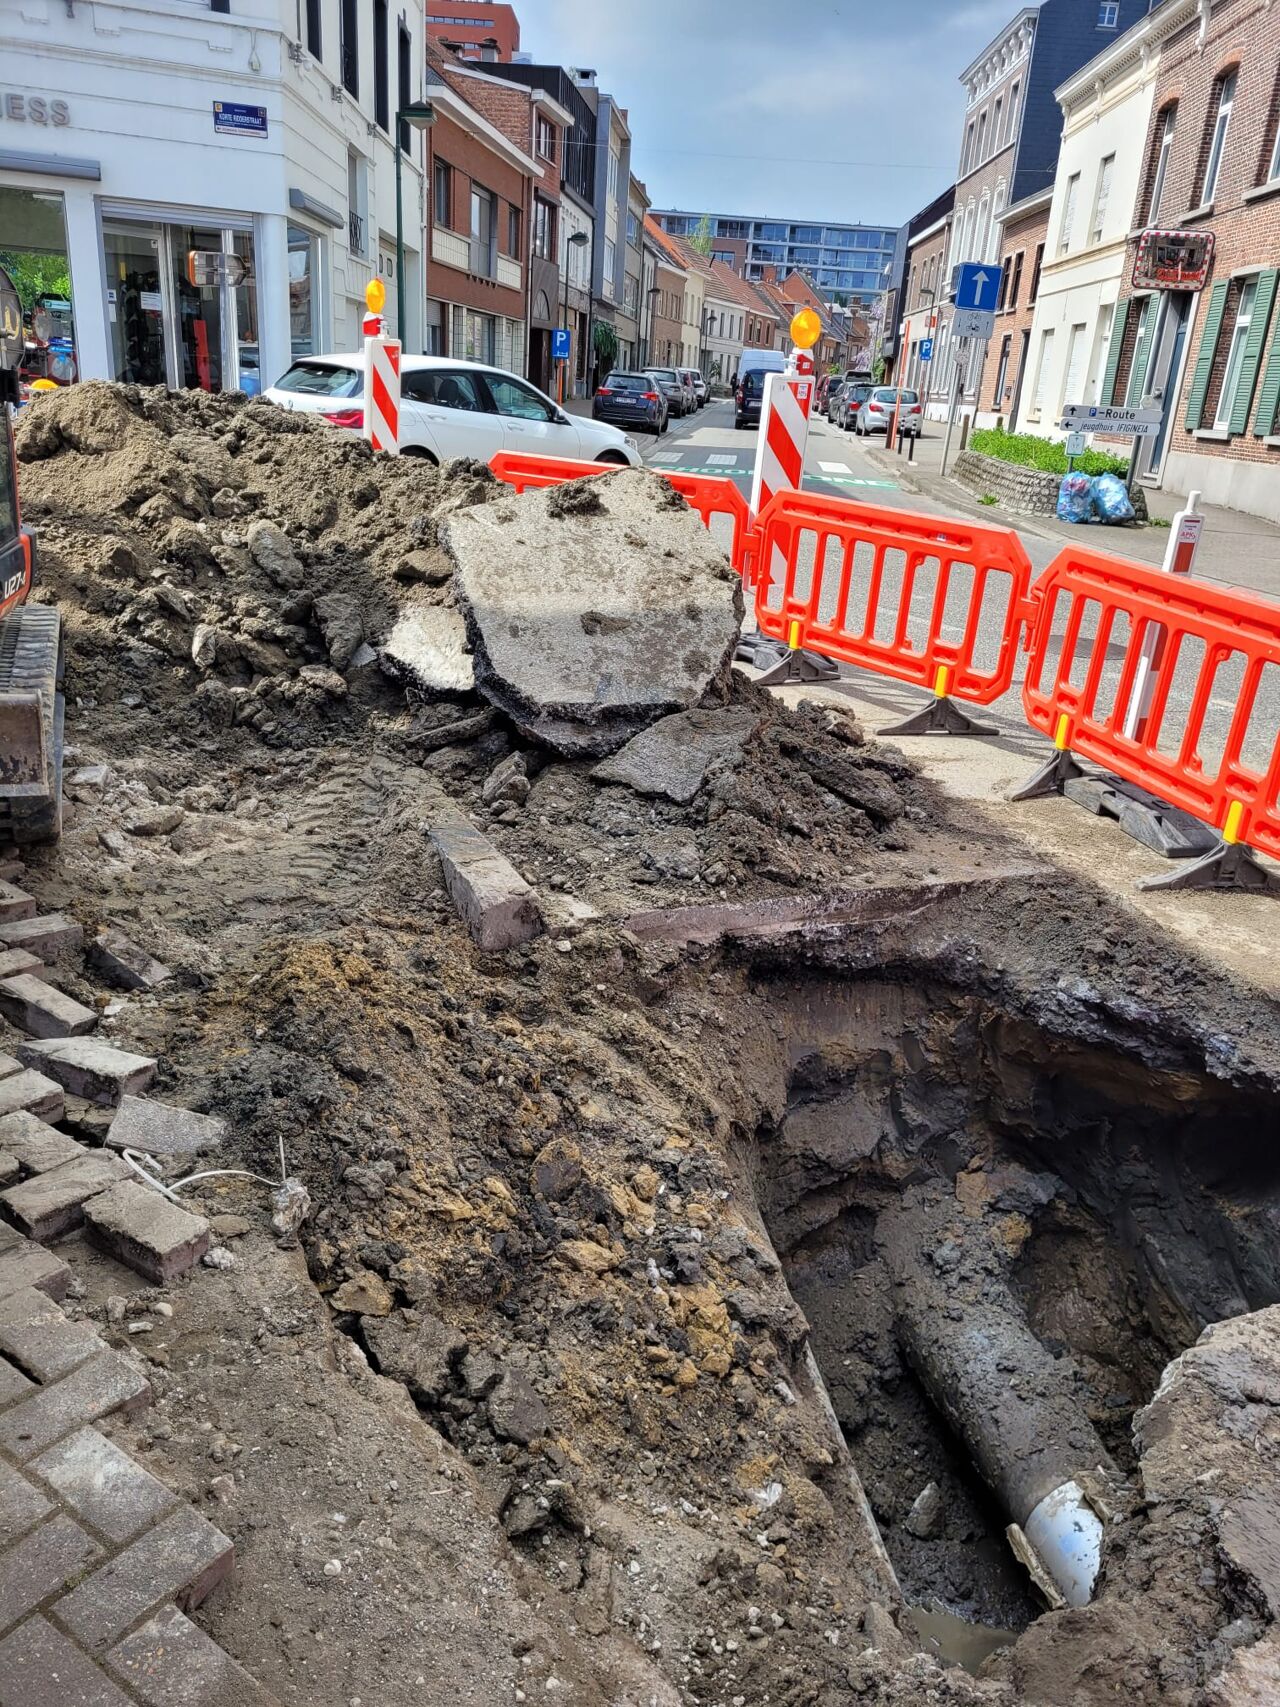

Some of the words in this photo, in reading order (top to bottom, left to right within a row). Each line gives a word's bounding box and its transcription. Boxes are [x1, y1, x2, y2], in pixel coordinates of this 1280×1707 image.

[0, 93, 70, 126] ESS
[556, 331, 566, 347] P
[1080, 422, 1114, 433] jeugdhuis
[803, 474, 897, 488] ONE
